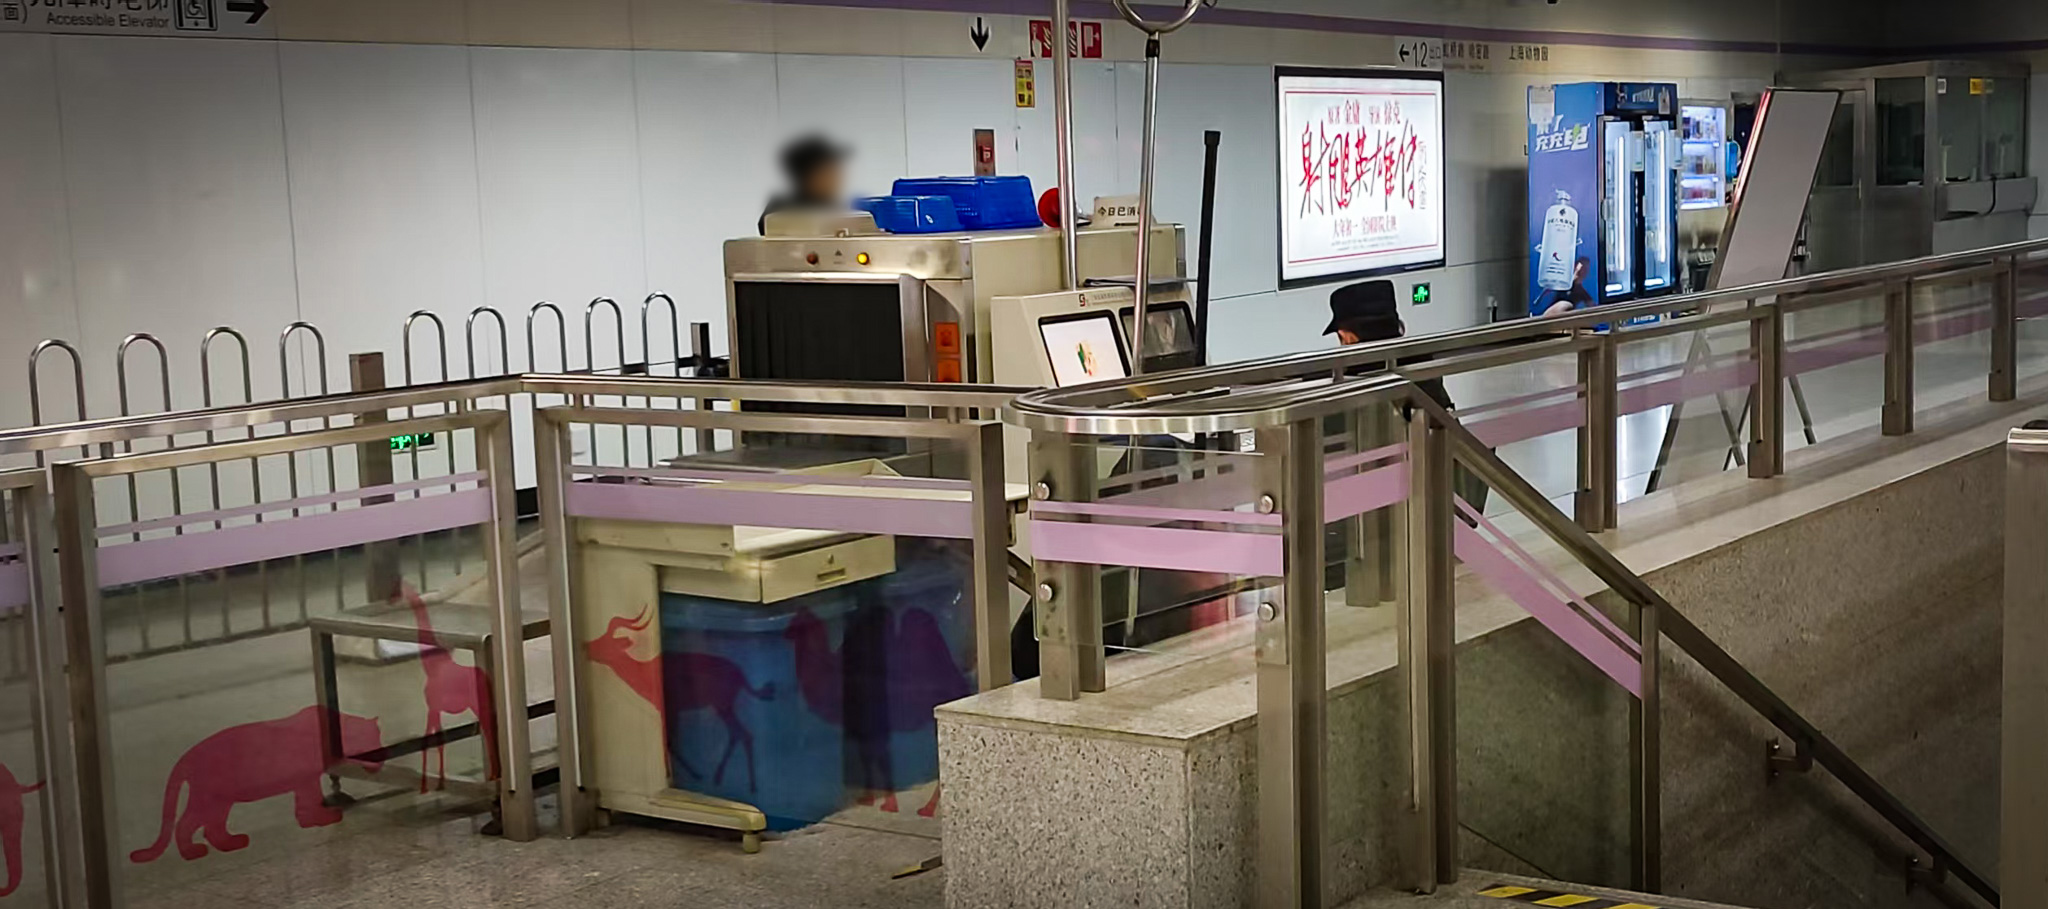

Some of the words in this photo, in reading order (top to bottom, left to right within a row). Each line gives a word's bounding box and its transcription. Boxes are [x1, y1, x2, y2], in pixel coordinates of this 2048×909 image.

[47, 12, 115, 27] Accessible
[119, 14, 169, 28] Elevator
[1098, 206, 1140, 216] 今日已消
